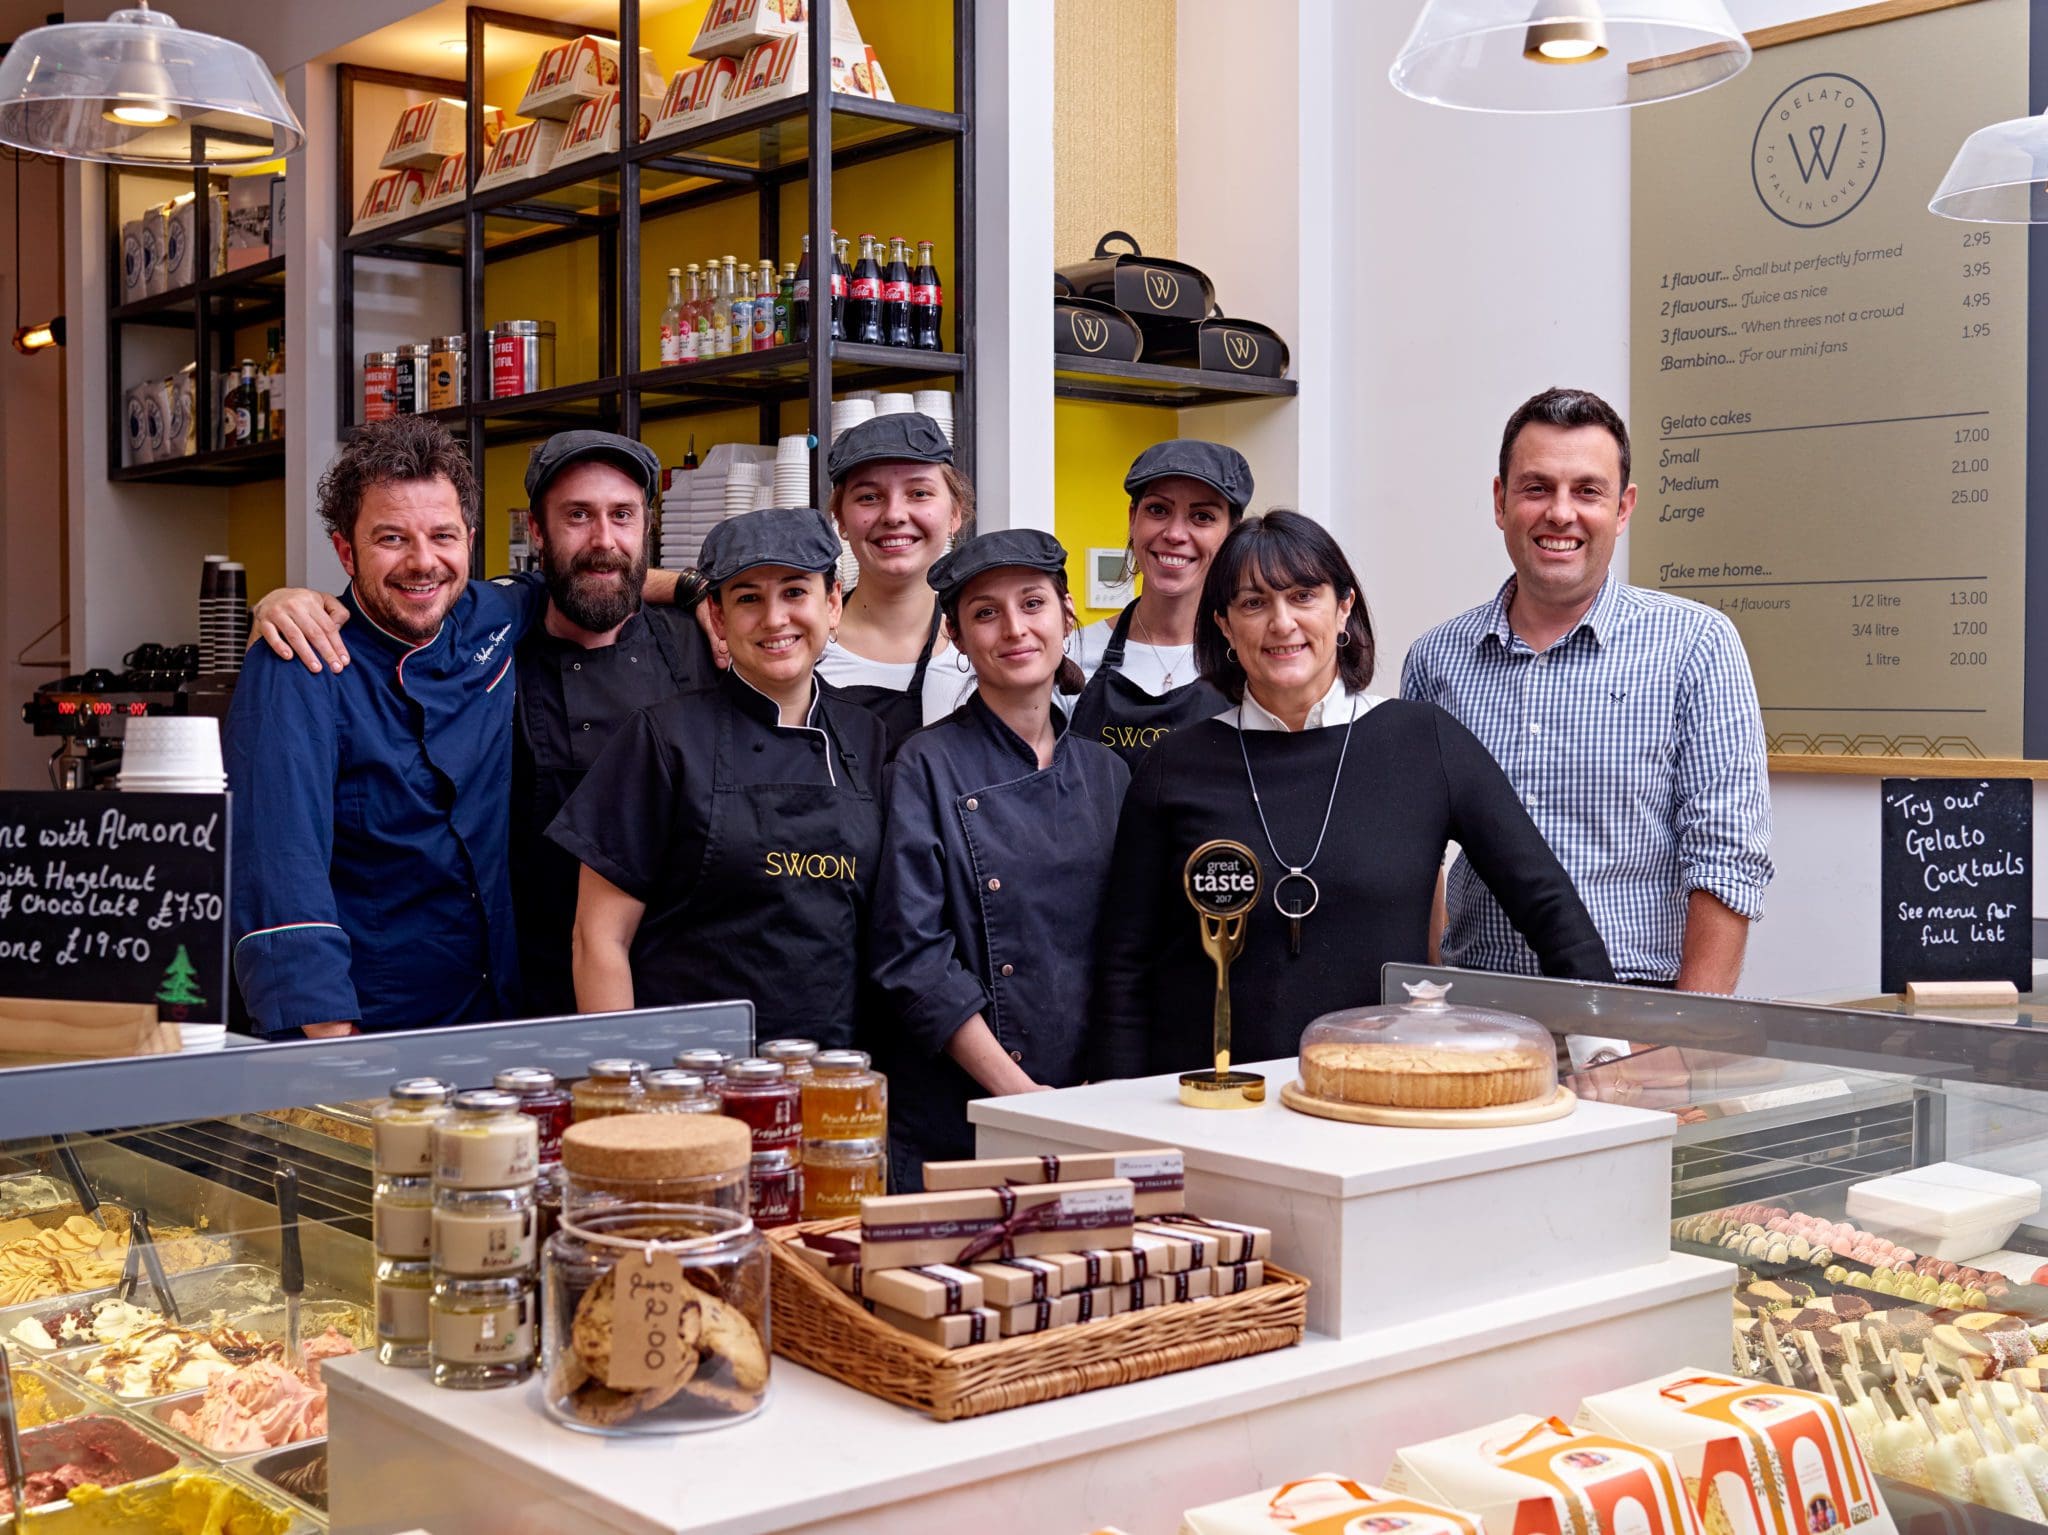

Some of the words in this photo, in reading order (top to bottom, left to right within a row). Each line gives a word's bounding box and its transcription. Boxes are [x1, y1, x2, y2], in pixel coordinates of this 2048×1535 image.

[1780, 89, 1855, 121] GELATO
[1766, 145, 1775, 163] TO
[1788, 123, 1847, 184] W
[1857, 127, 1870, 169] WITH
[1769, 173, 1791, 204] FALL
[1822, 178, 1856, 208] LOVE
[1799, 202, 1813, 210] IN
[1963, 231, 1991, 248] 2.95
[1660, 274, 1668, 289] 1
[1671, 270, 1729, 291] flavour...
[1732, 262, 1768, 282] Small
[1771, 261, 1791, 274] but
[1793, 251, 1851, 274] perfectly
[1853, 243, 1903, 264] formed
[1962, 261, 1991, 278] 3.95
[1660, 302, 1670, 316] 2
[1671, 297, 1737, 318] flavours...
[1741, 291, 1780, 308] Twice
[1783, 290, 1798, 300] as
[1800, 285, 1828, 297] nice
[1962, 292, 1991, 308] 4.95
[1660, 329, 1670, 343] 3
[1671, 324, 1737, 345] flavours...
[1741, 320, 1780, 334] When
[1783, 315, 1822, 329] threes
[1824, 311, 1846, 324] not
[1848, 311, 1858, 322] a
[1860, 303, 1905, 320] crowd
[1962, 323, 1991, 339] 1.95
[1660, 352, 1735, 372] Bambino...
[1739, 349, 1762, 365] For
[1765, 348, 1787, 360] our
[1790, 343, 1818, 357] mini
[1819, 341, 1848, 360] fans
[1661, 414, 1707, 435] Gelato
[1710, 410, 1752, 426] cakes
[1954, 428, 1990, 444] 17.00
[1659, 448, 1700, 468] Small
[1951, 458, 1989, 474] 21.00
[1659, 475, 1719, 495] Medium
[1951, 488, 1989, 504] 25.00
[1659, 504, 1705, 522] Large
[1659, 562, 1695, 583] Take
[1698, 566, 1720, 577] me
[1722, 562, 1772, 577] home...
[1718, 598, 1738, 611] 1-4
[1740, 598, 1791, 613] flavours
[1852, 594, 1874, 608] 1/2
[1877, 594, 1901, 607] litre
[1950, 591, 1988, 605] 13.00
[1851, 624, 1873, 637] 3/4
[1875, 623, 1900, 636] litre
[1951, 621, 1988, 636] 17.00
[1865, 654, 1873, 666] 1
[1876, 652, 1901, 666] litre
[1950, 652, 1987, 666] 20.00
[39, 817, 91, 847] with
[96, 807, 218, 852] Almond
[1905, 825, 1985, 863] Gelato
[765, 852, 857, 881] SWOON
[1207, 860, 1240, 875] great
[1923, 849, 2024, 892] Cocktails
[44, 860, 156, 899] Hazelnut
[1193, 872, 1255, 892] taste
[1215, 894, 1233, 904] 2017
[1898, 901, 1923, 921] See
[1927, 905, 1978, 919] menu
[1986, 902, 2017, 922] for
[1920, 924, 1959, 947] full
[1970, 922, 2005, 942] list
[630, 1272, 674, 1370] £2.00
